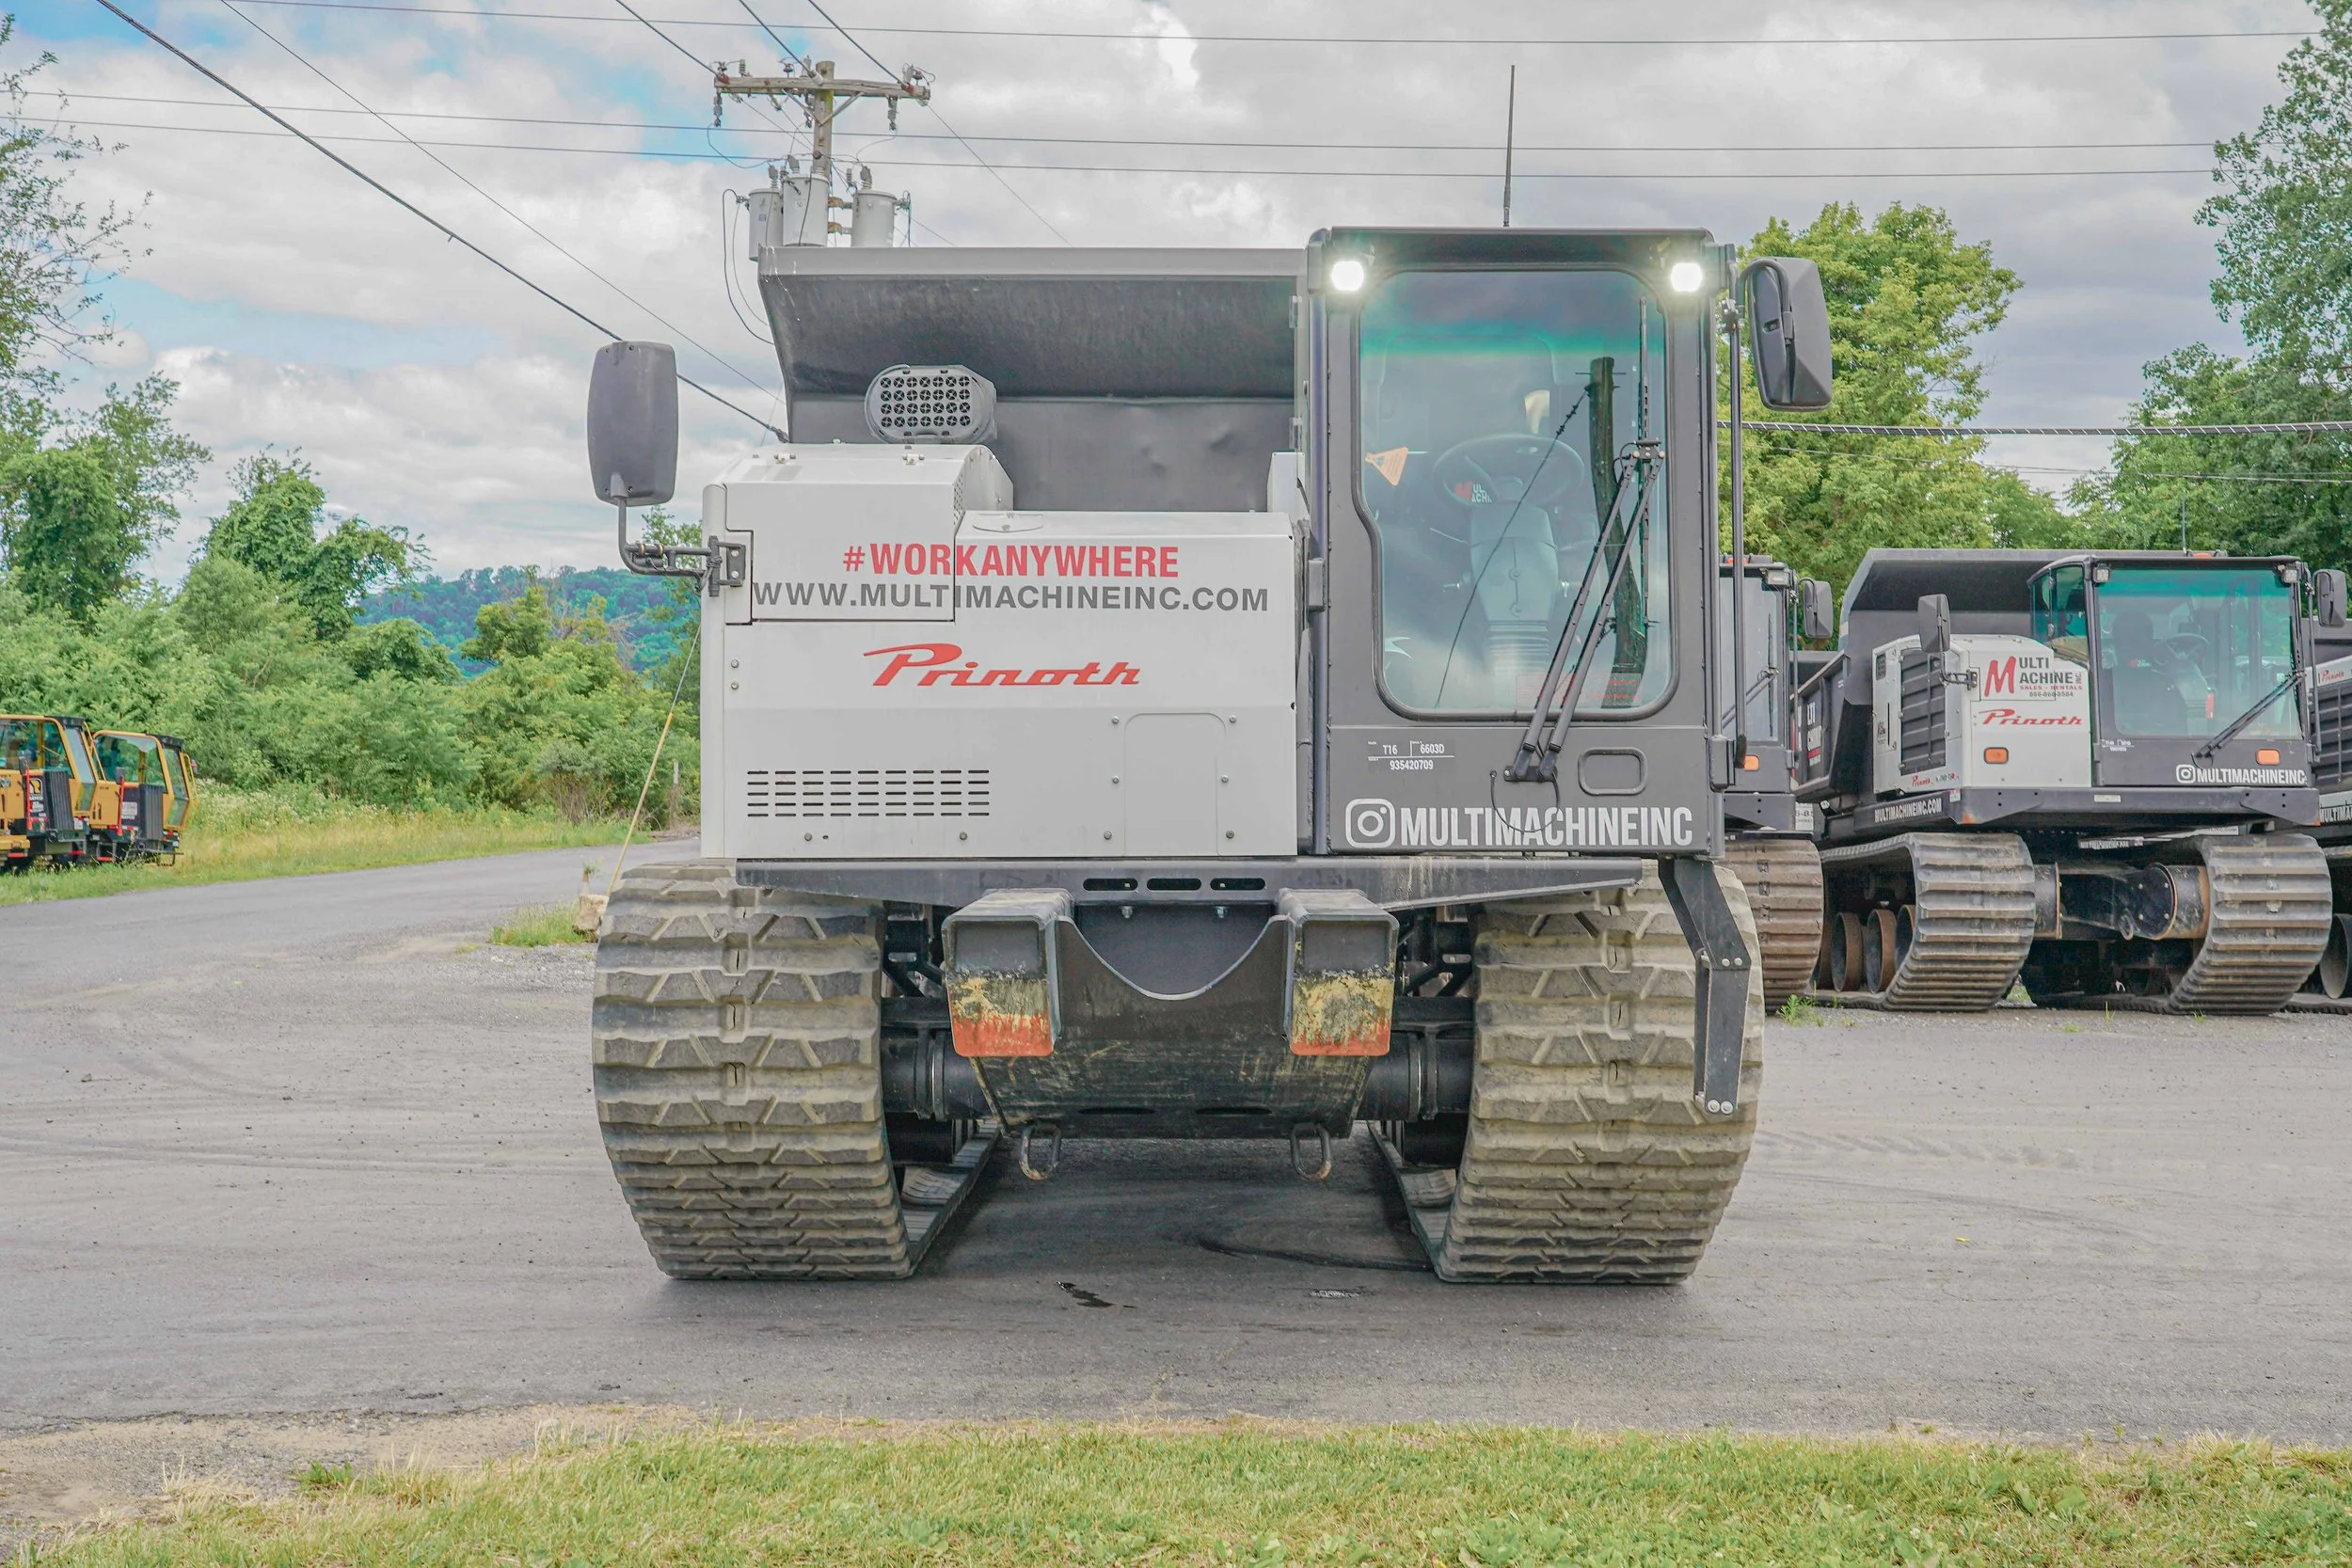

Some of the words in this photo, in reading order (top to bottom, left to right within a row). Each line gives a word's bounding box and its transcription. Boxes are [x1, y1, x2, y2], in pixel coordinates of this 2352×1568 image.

[843, 543, 1179, 578] #WORKANYWHERE
[754, 582, 1268, 611] WWW.MULTIMACHINEINC.COM
[864, 642, 1140, 687] Prinoth
[1979, 708, 2082, 725] Prinoth
[1382, 744, 1398, 755] T16
[1420, 743, 1445, 754] 6603D
[1390, 759, 1434, 770] 935420709
[2197, 768, 2306, 784] MULTIMACHINEINC
[1874, 797, 1943, 823] MULTIMACHINEINC.COM
[1400, 806, 1693, 847] MULTIMACHINEINC
